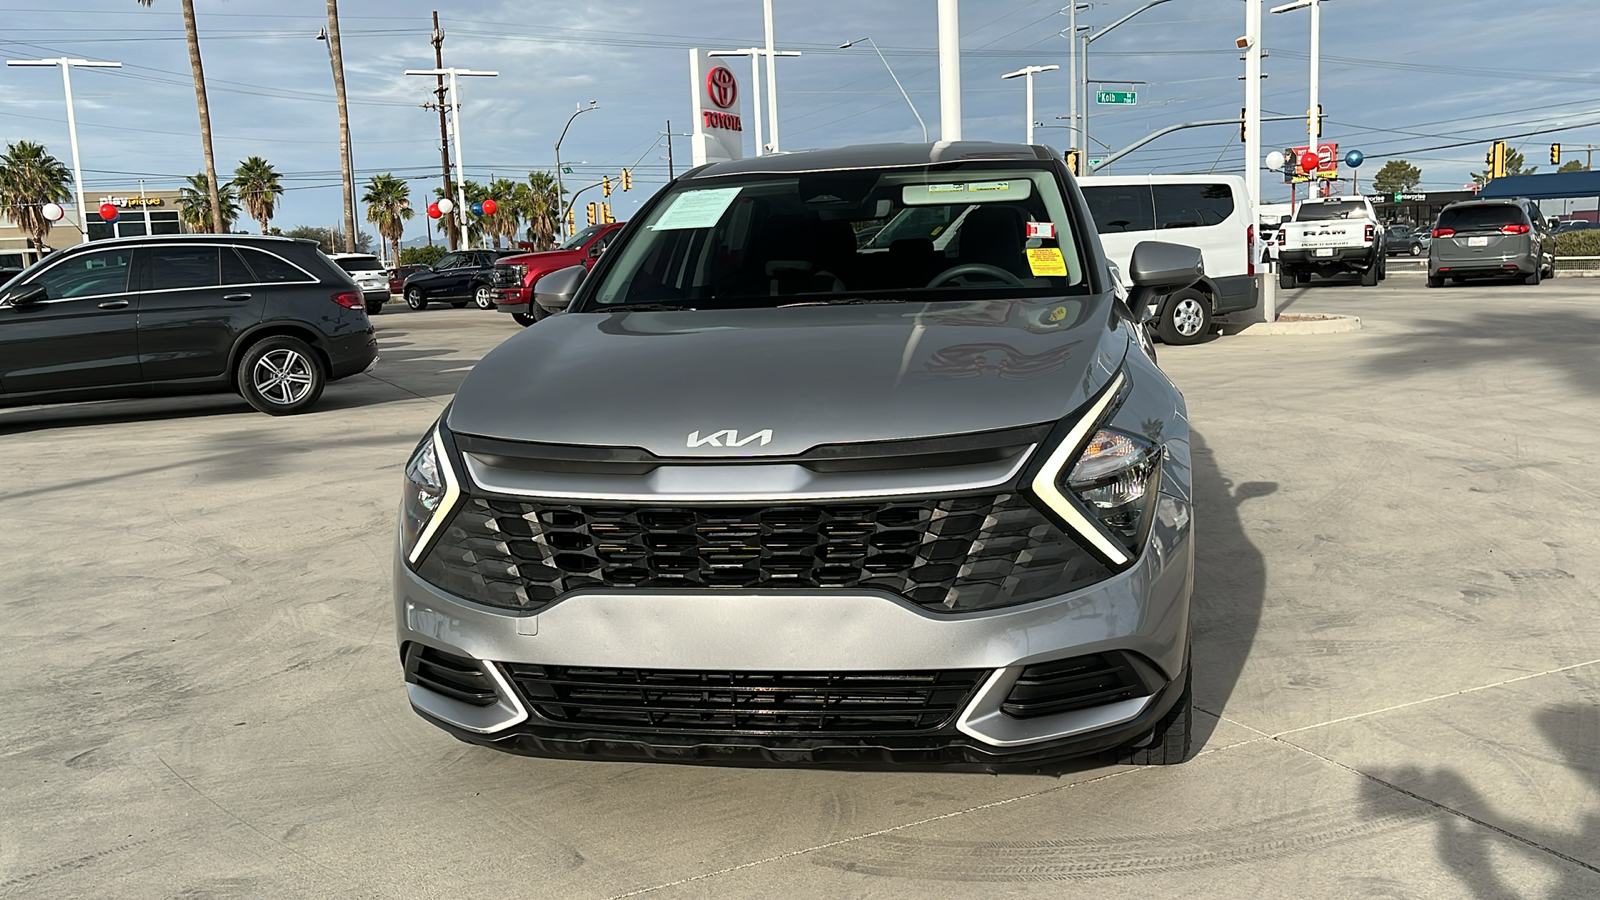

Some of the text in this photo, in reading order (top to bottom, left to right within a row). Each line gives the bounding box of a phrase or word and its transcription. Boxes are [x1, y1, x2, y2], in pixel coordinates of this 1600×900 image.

[1101, 92, 1116, 103] Kolb
[702, 110, 742, 132] TOYOTA
[1303, 229, 1346, 237] RAM
[686, 429, 773, 448] KIA
